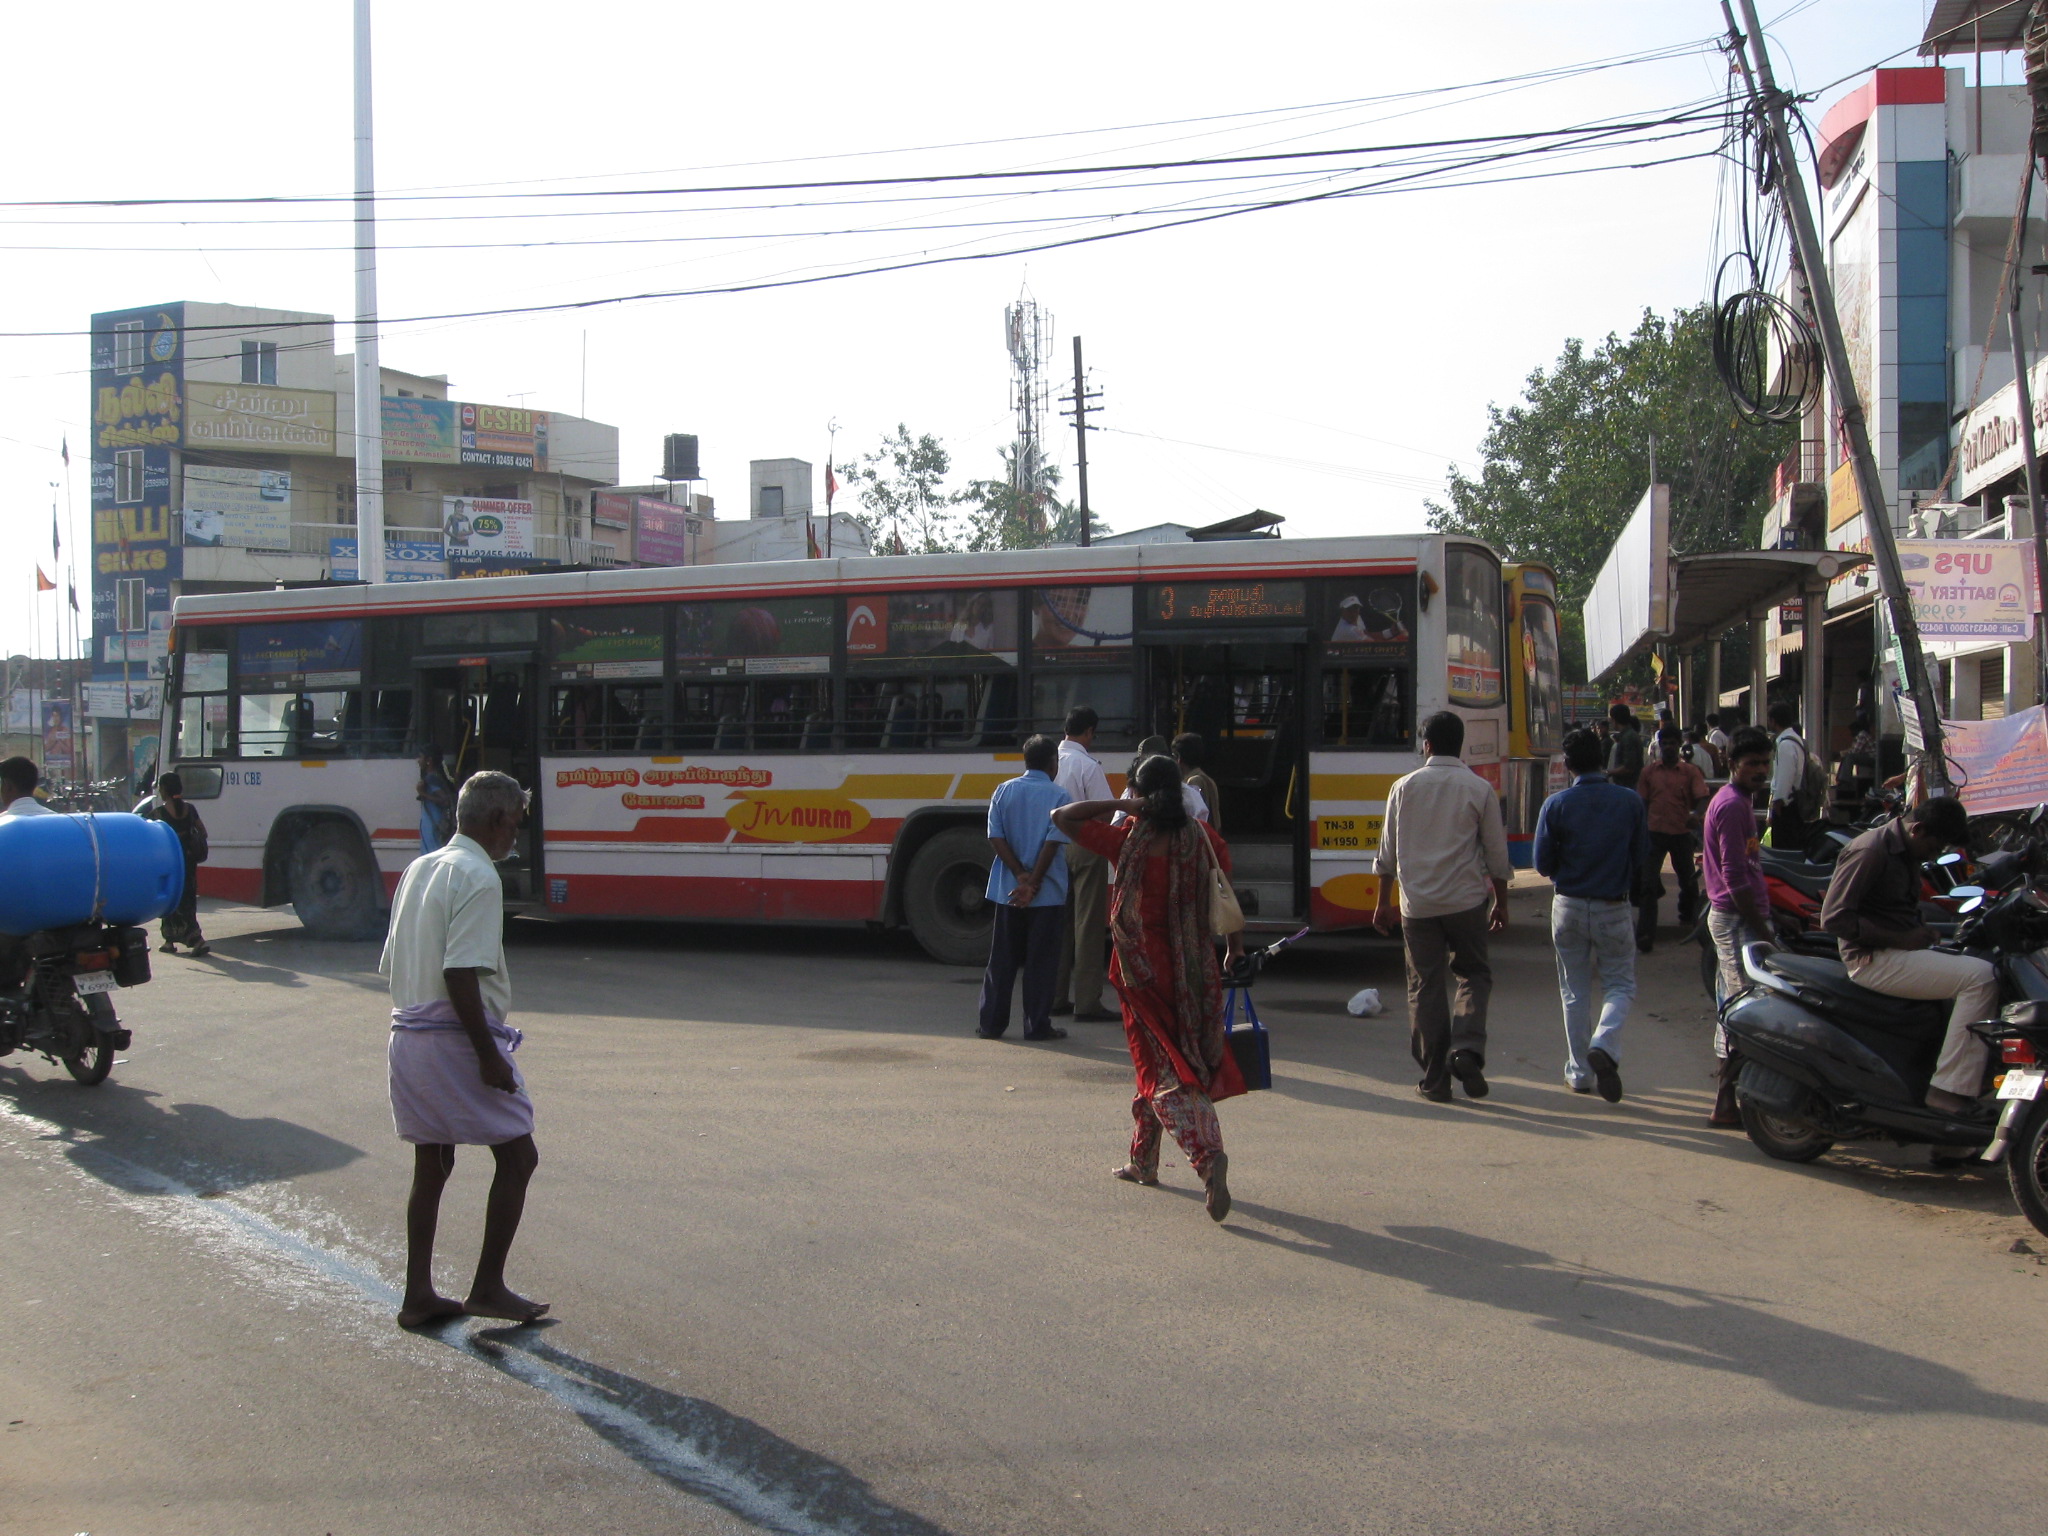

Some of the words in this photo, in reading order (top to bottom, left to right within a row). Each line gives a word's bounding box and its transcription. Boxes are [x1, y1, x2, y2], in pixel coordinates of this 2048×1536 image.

[479, 407, 532, 432] CSRI
[462, 451, 491, 464] CONTACT
[472, 500, 505, 512] SUMMER
[507, 503, 532, 514] OFFER
[478, 519, 498, 529] 75%
[98, 549, 167, 573] SILKS
[1161, 586, 1175, 619] 3
[1474, 671, 1481, 692] 3
[226, 771, 240, 785] 191
[244, 771, 262, 785] CBE
[557, 768, 639, 788] தமிழ்நாடு
[1324, 821, 1355, 830] TN-38
[1333, 837, 1358, 846] 1950
